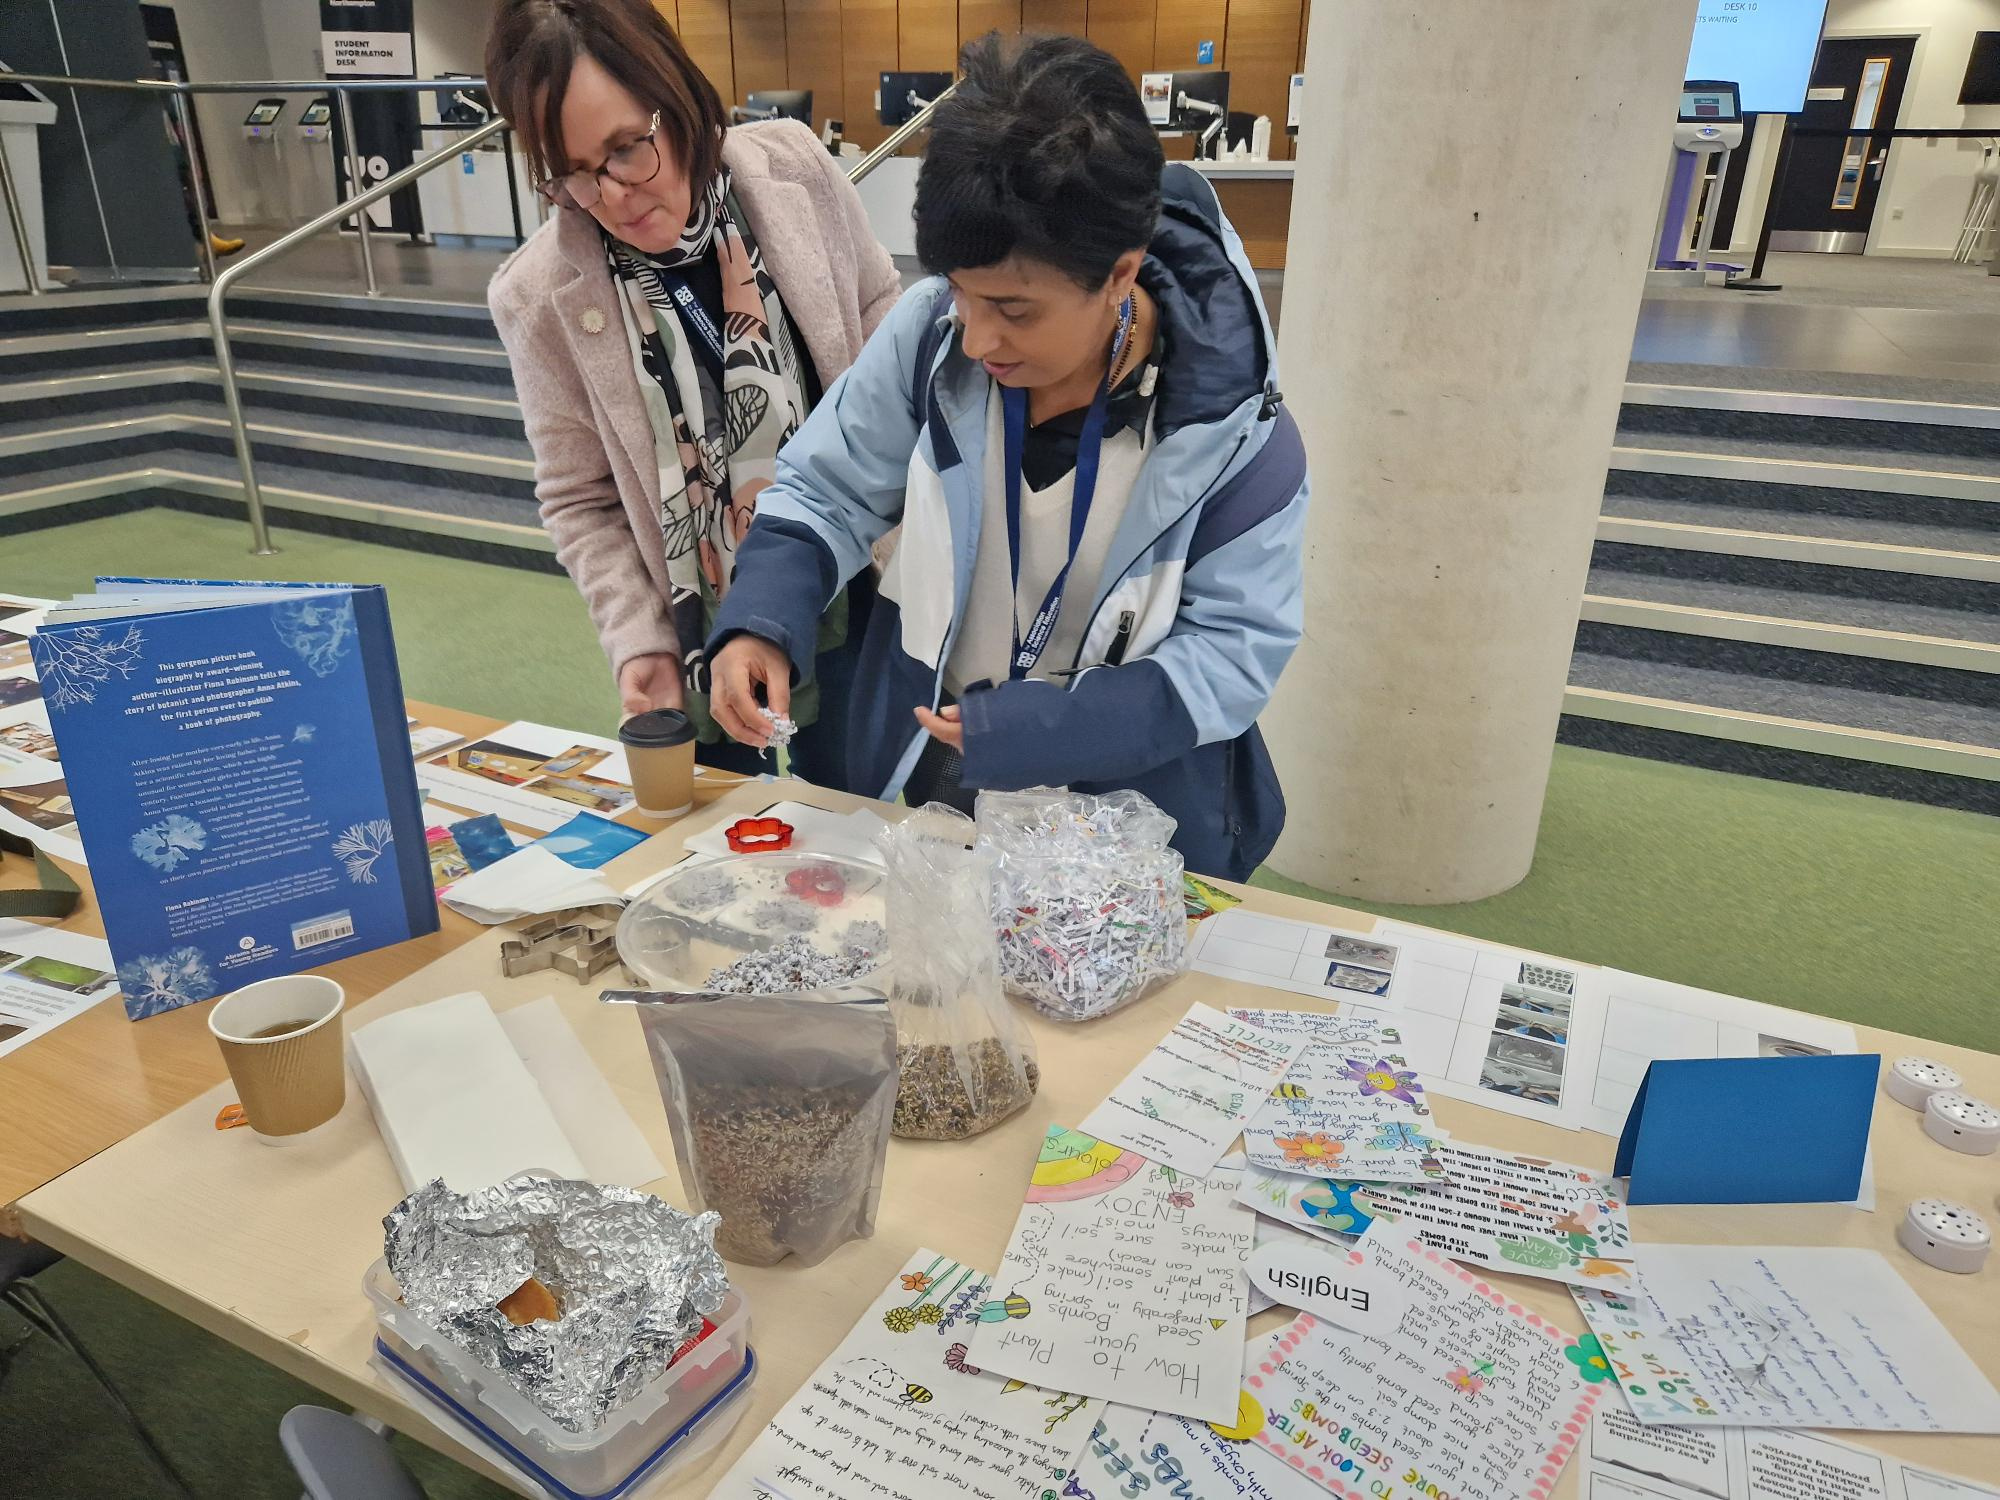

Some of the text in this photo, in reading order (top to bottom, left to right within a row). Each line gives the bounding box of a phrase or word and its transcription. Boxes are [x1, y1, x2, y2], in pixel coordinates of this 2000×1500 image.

[1724, 2, 1758, 11] DESK 10
[691, 309, 708, 331] Science
[698, 307, 719, 337] Association
[1026, 611, 1047, 644] Association
[1031, 625, 1047, 648] Science
[1042, 597, 1059, 625] Education
[157, 650, 256, 671] This gorgeous picture book
[155, 673, 192, 684] biography
[206, 661, 263, 676] award-winning
[131, 683, 202, 701] author-illustrator
[203, 680, 224, 689] Fiona
[225, 675, 258, 685] Robinson
[259, 671, 277, 679] tells
[124, 679, 301, 715] story of botanist and photographer Anna Atkins,
[160, 713, 174, 721] the
[175, 709, 192, 718] first
[193, 706, 219, 716] person
[219, 702, 235, 710] ever
[247, 695, 273, 707] publish
[184, 720, 203, 729] book
[204, 717, 212, 725] of
[214, 710, 262, 725] photography.
[164, 896, 209, 911] Fiona Robinson
[1224, 1023, 1291, 1054] RECYCLE
[1148, 1168, 1163, 1182] of
[1371, 1202, 1401, 1214] AUTUMN
[1414, 1212, 1433, 1222] THEM
[1091, 1215, 1249, 1243] always moist
[1436, 1217, 1458, 1227] PLANT
[1460, 1223, 1475, 1232] YOU
[1479, 1227, 1495, 1236] SURE
[1029, 1215, 1248, 1261] 2. make sure soil is
[1419, 1229, 1468, 1247] SEED BOMBS
[1499, 1231, 1518, 1240] MAKE
[1004, 1251, 1033, 1267] sure
[1425, 1239, 1488, 1260] HOW TO PLANT
[1064, 1254, 1151, 1277] somewhere
[1165, 1261, 1192, 1270] can
[1096, 1274, 1133, 1290] soil
[1165, 1274, 1201, 1287] plant
[1218, 1282, 1234, 1293] to
[1267, 1267, 1370, 1312] English
[1153, 1284, 1168, 1299] in
[1177, 1290, 1221, 1308] plant
[1043, 1282, 1202, 1324] preferably in Spring
[1228, 1296, 1243, 1313] 1.
[1048, 1303, 1203, 1345] Seed Bombs
[1084, 1332, 1138, 1352] your
[1322, 1337, 1334, 1348] in
[997, 1330, 1199, 1398] How to Plant
[1295, 1359, 1307, 1370] in
[1338, 1346, 1376, 1373] gently
[1311, 1368, 1340, 1393] deep
[1376, 1373, 1407, 1398] bomb
[1314, 1388, 1330, 1405] the
[1333, 1401, 1345, 1412] in
[1347, 1393, 1364, 1404] cm
[1376, 1389, 1397, 1407] soil
[1410, 1394, 1440, 1415] seed
[1350, 1412, 1388, 1442] bombs
[1403, 1403, 1436, 1431] damp
[1449, 1417, 1478, 1438] your
[1603, 1418, 1638, 1434] money
[1402, 1425, 1433, 1447] about
[1443, 1431, 1468, 1450] nice
[1449, 1401, 1524, 1459] the ground
[1608, 1427, 1661, 1448] recording
[1392, 1437, 1421, 1459] seed
[1654, 1434, 1695, 1450] amount
[1758, 1442, 1802, 1460] service.
[1322, 1444, 1364, 1483] LOOK
[1440, 1447, 1464, 1469] hole
[1487, 1442, 1517, 1469] Place
[1677, 1448, 1698, 1460] way
[1698, 1448, 1715, 1458] the
[1701, 1456, 1709, 1464] A
[1426, 1462, 1458, 1480] your
[1483, 1466, 1503, 1492] dig
[1815, 1459, 1870, 1483] providing
[1370, 1479, 1392, 1500] TO
